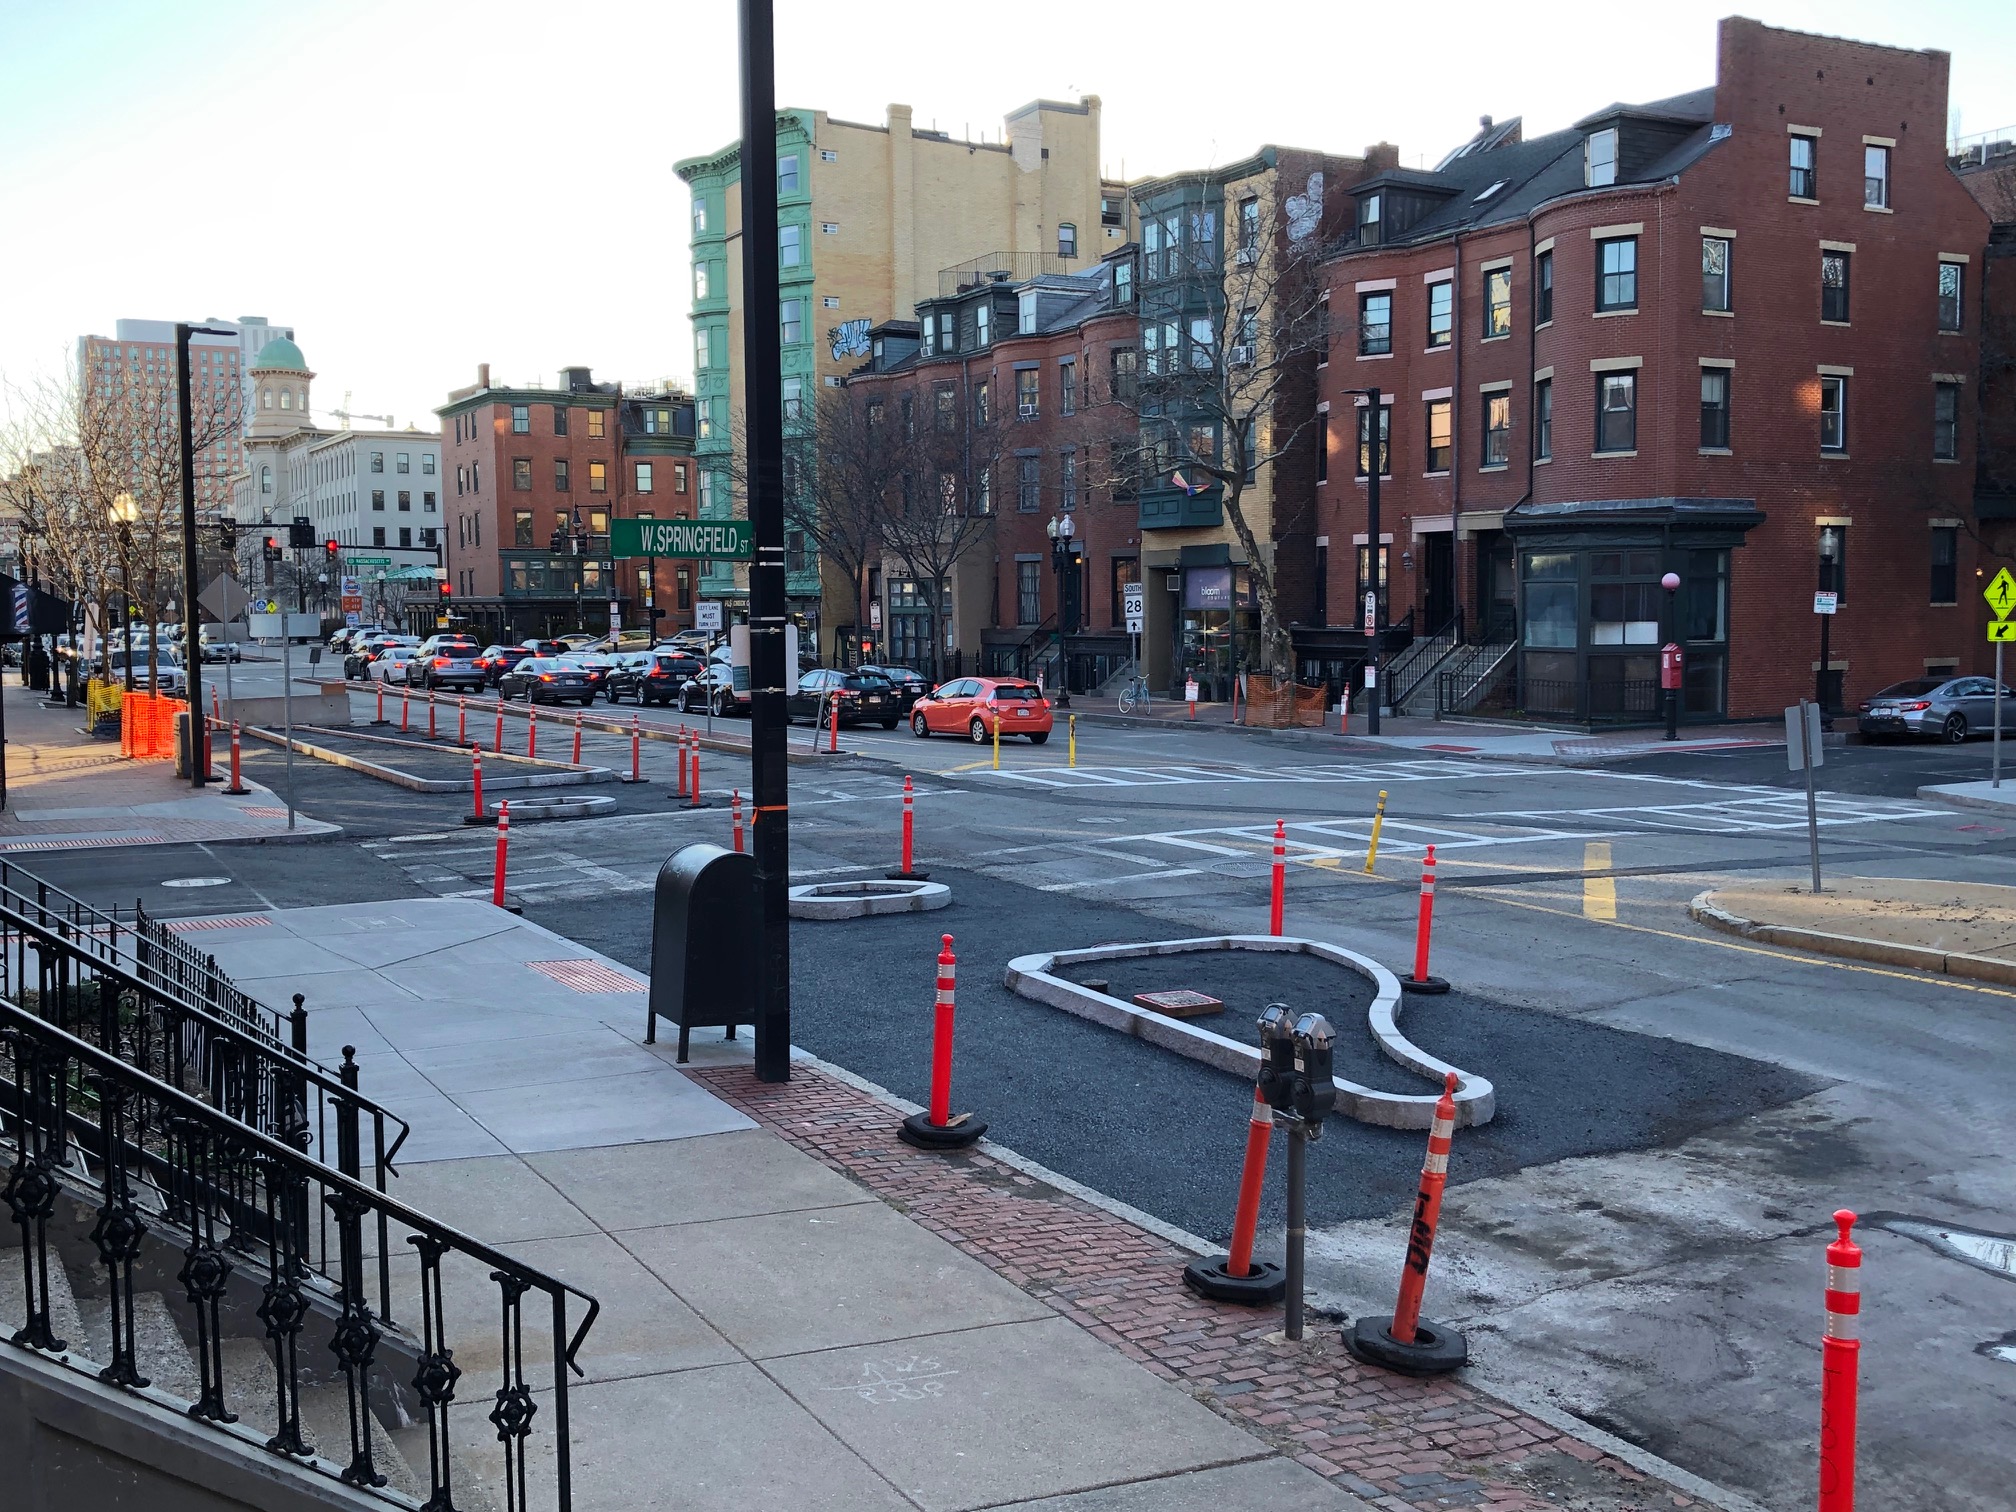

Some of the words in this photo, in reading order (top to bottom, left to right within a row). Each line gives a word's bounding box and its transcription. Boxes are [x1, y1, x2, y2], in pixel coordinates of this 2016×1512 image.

[641, 525, 738, 552] W.SPRINGFIELD
[740, 540, 748, 553] ST
[1124, 584, 1142, 592] SOUTH
[1200, 586, 1220, 596] bloom
[1126, 600, 1142, 613] 28
